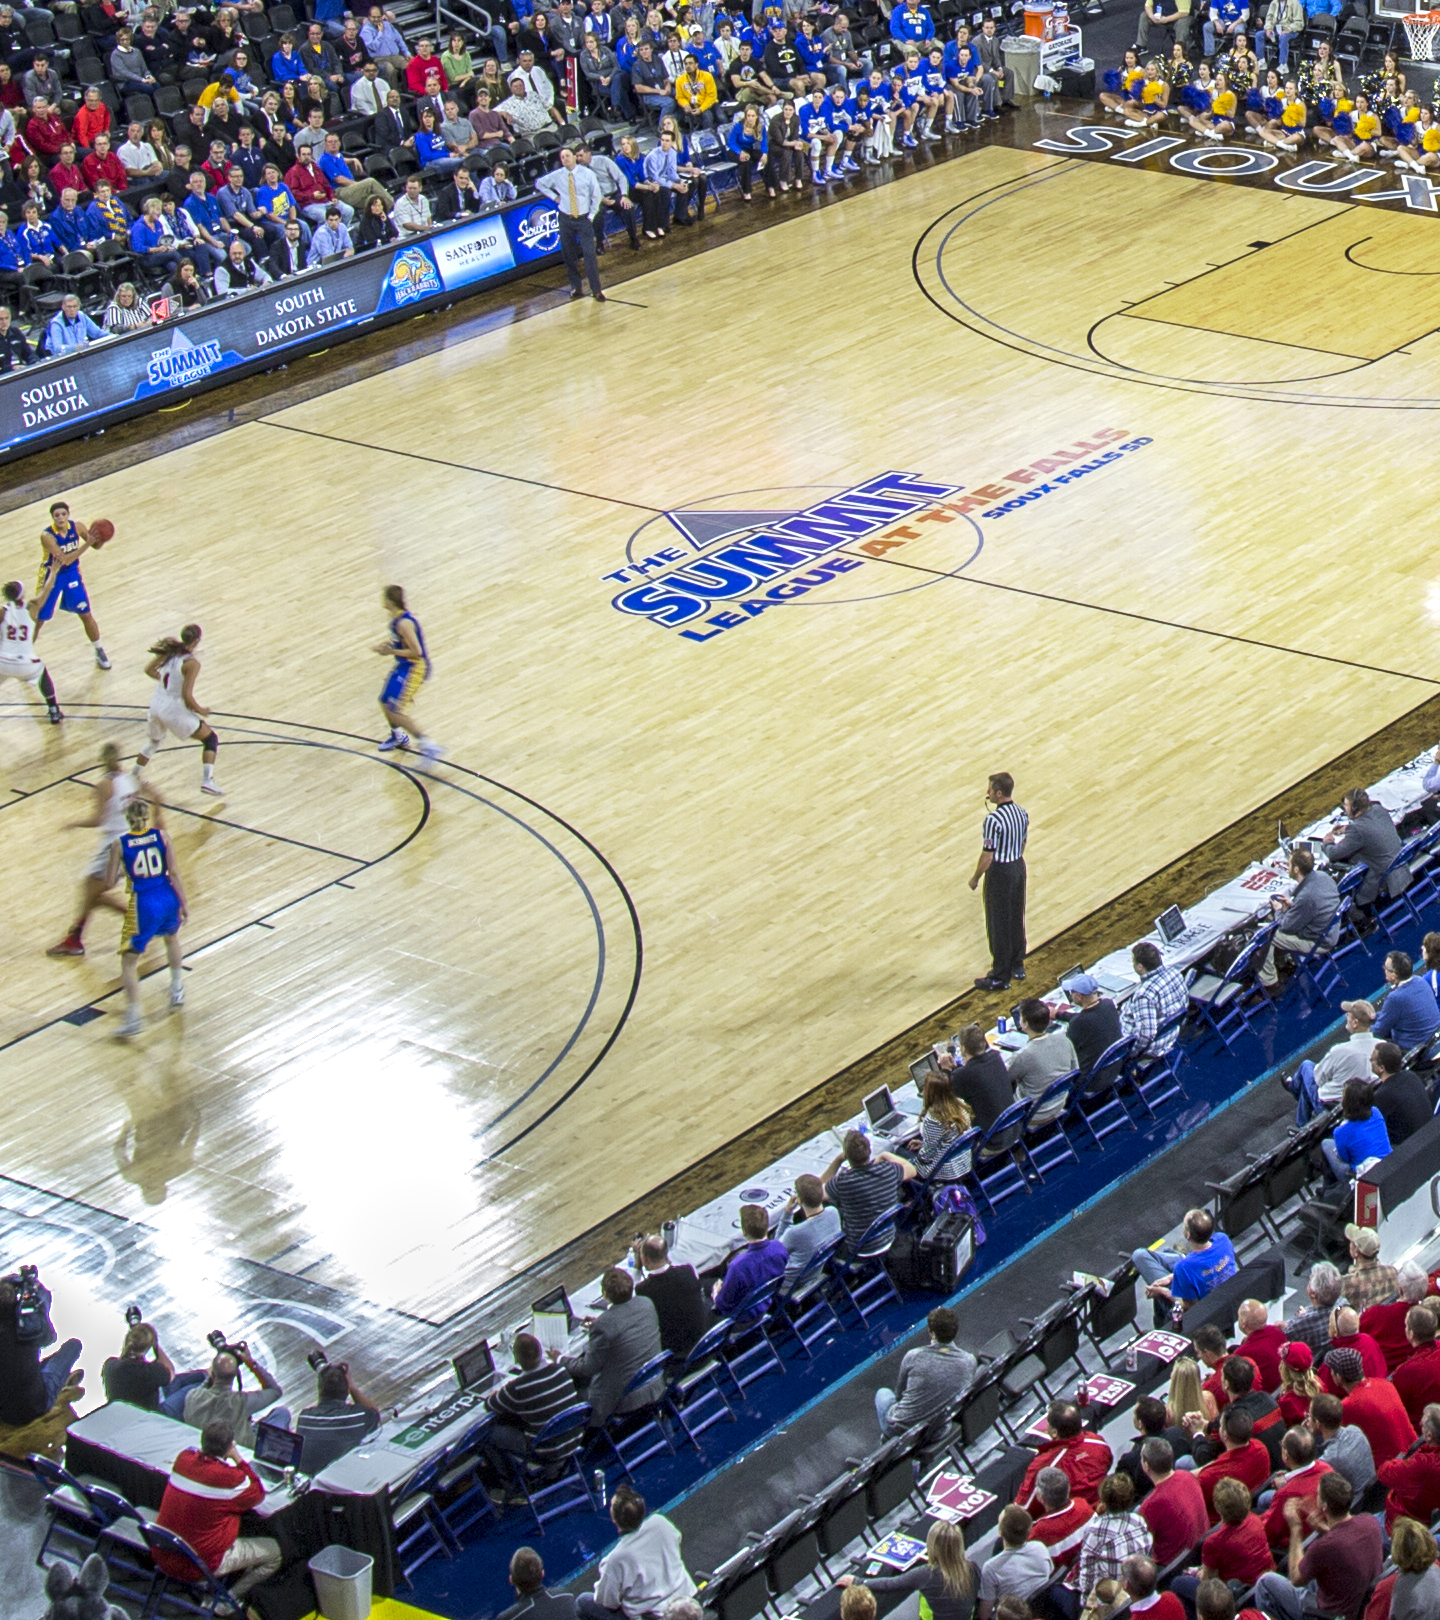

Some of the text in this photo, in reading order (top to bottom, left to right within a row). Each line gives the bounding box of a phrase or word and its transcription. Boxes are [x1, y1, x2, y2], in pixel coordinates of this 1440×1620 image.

[445, 235, 497, 262] SANFORD
[274, 287, 326, 316] SOUTH
[255, 298, 357, 346] DAKOTA STATE
[147, 339, 222, 386] SUMMIT
[169, 365, 212, 387] LEAGUE
[20, 375, 78, 408] SOUTH
[22, 393, 90, 429] DAKOTA
[858, 426, 1133, 558] AT THE FALLS
[980, 436, 1155, 521] SIOUX FALLS SD
[600, 545, 692, 584] THE
[610, 470, 966, 629] SUMMIT
[677, 556, 866, 644] LEAGUE
[5, 624, 29, 642] 23
[131, 847, 163, 878] 40
